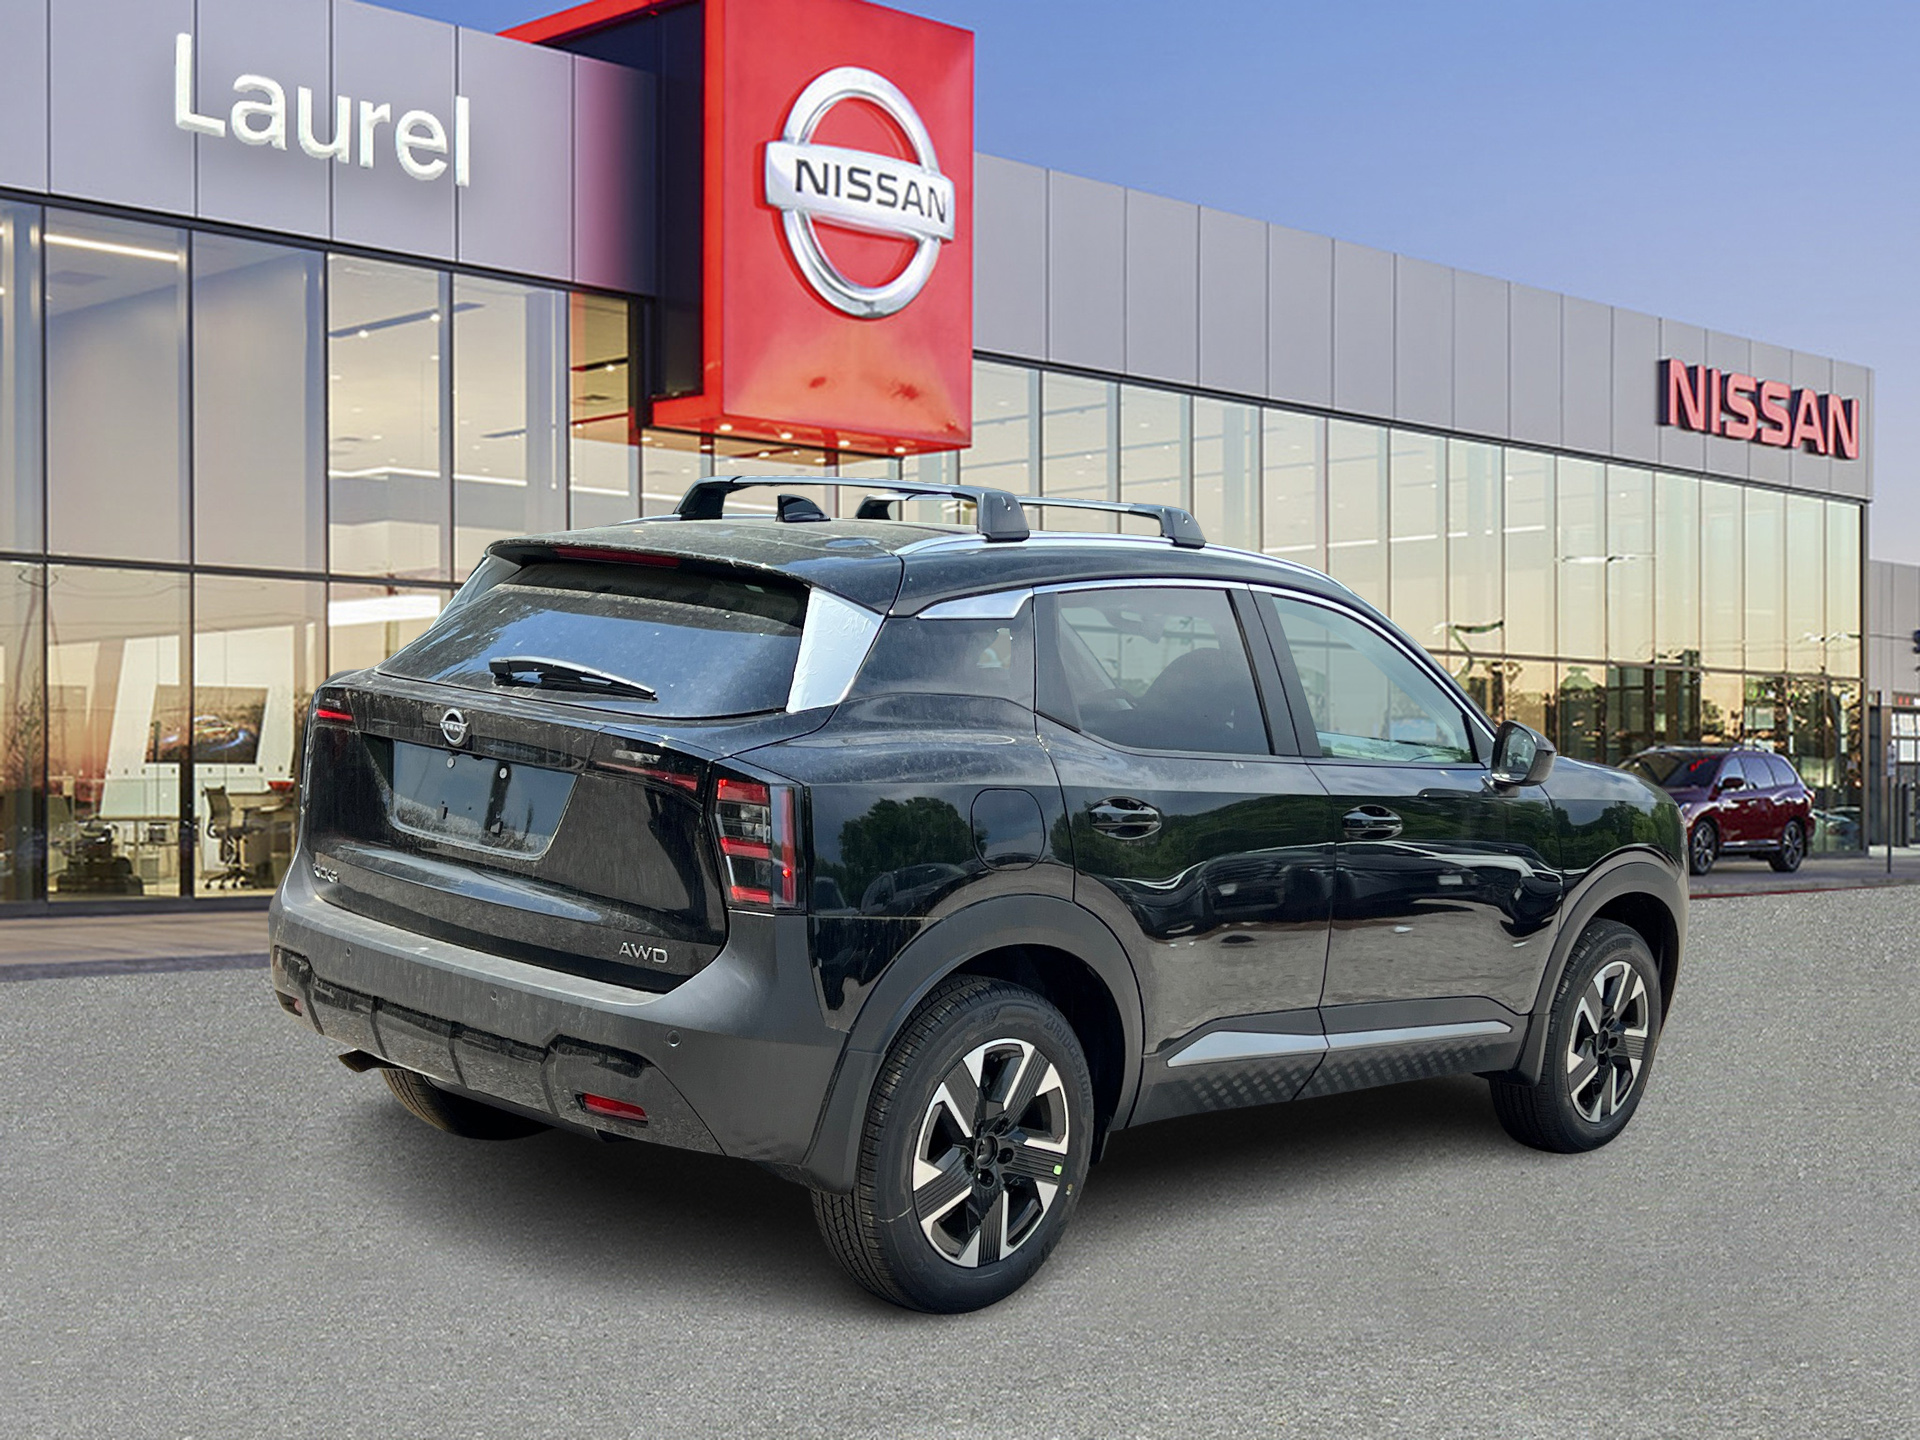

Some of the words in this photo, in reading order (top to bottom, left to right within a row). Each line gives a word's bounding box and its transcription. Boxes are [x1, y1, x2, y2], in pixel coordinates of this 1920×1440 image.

[175, 32, 470, 188] Laurel
[795, 158, 947, 224] NISSAN
[1659, 358, 1859, 460] NISSAN
[618, 942, 669, 964] AWD
[1043, 1013, 1092, 1110] BRIDGESTON
